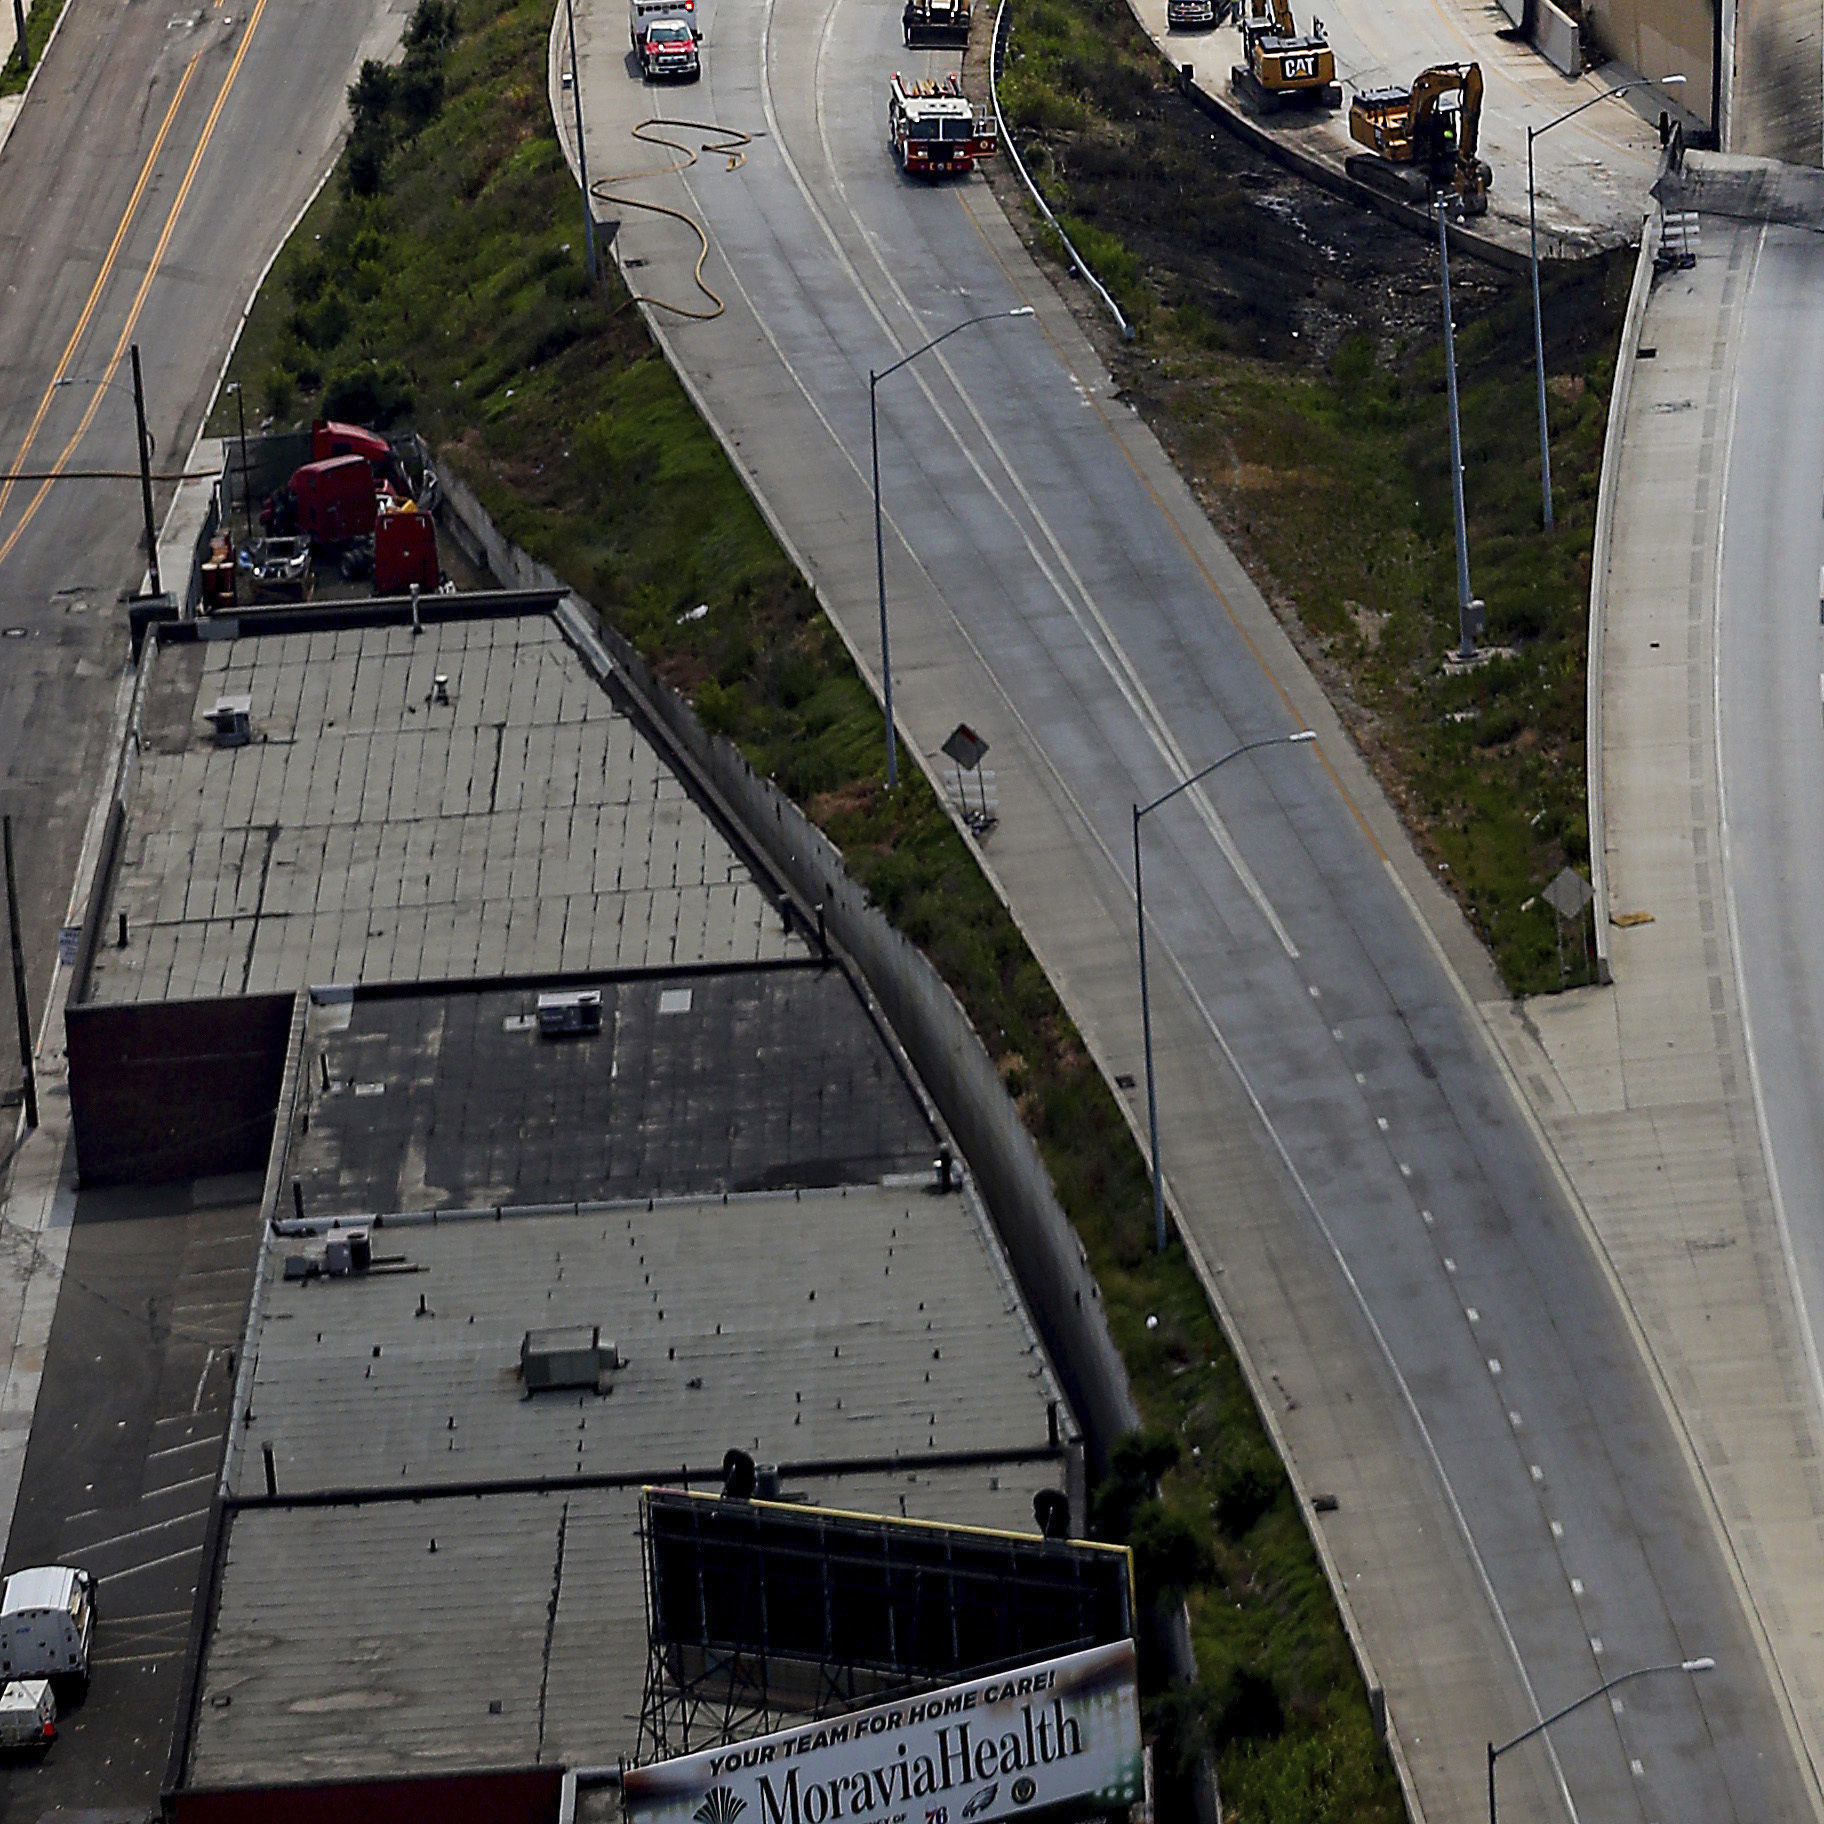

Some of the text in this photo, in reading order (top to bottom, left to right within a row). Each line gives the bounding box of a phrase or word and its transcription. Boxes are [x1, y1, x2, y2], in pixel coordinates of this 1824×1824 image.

[1285, 57, 1314, 77] CAT
[710, 1670, 1056, 1775] YOUR TEAM FOR HOME CARE!
[755, 1697, 1083, 1824] MoraviaHealth
